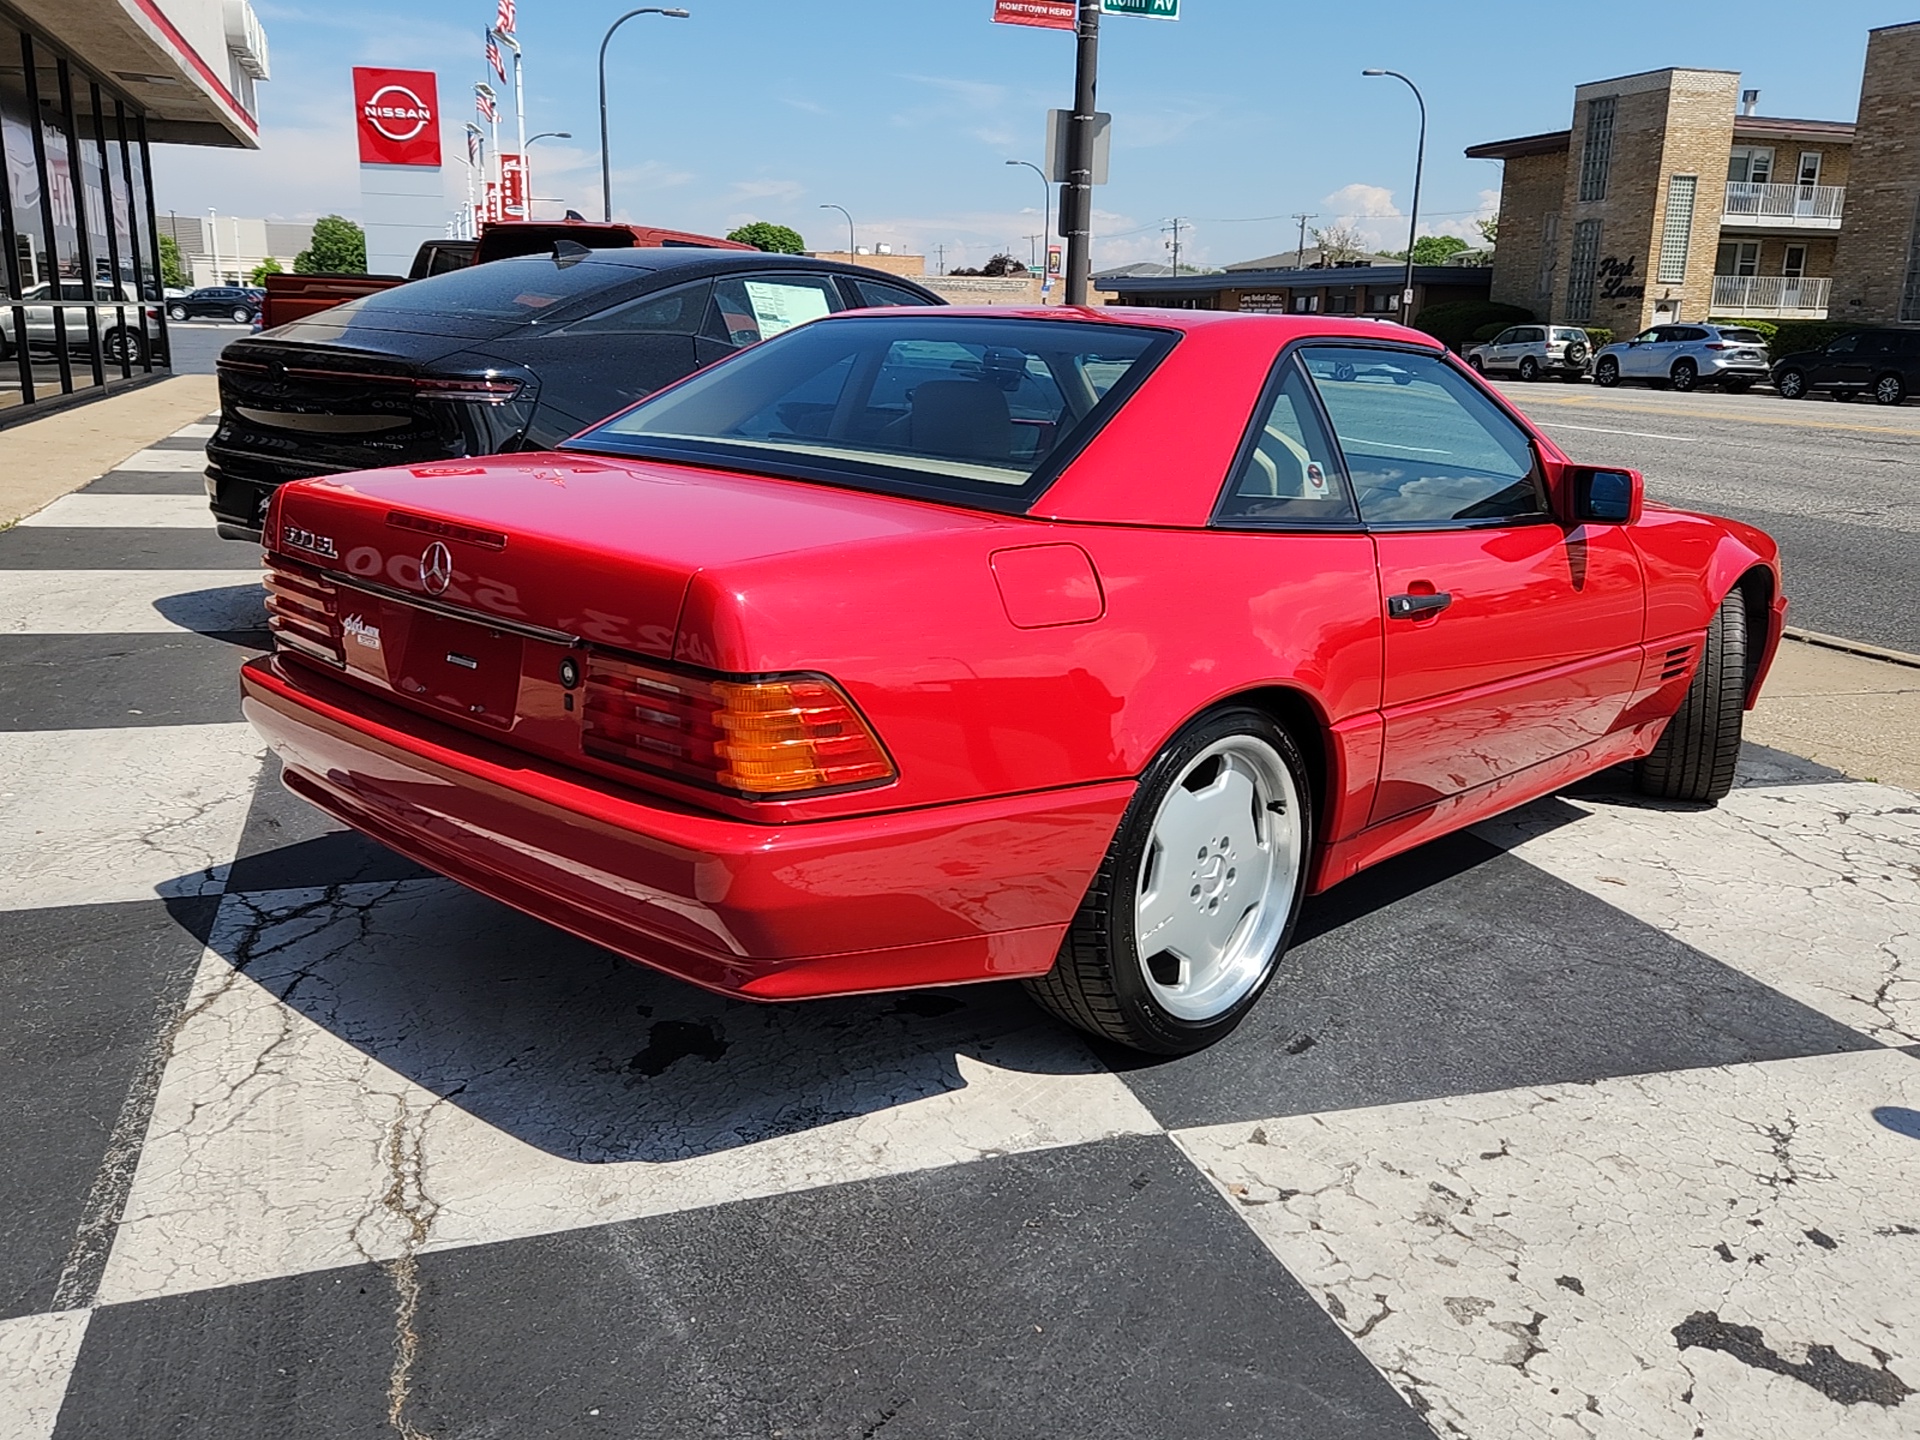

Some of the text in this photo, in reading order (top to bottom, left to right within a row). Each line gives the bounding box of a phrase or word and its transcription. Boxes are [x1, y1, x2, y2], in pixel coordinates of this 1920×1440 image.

[999, 2, 1073, 17] HOMETOWN HERO
[364, 106, 431, 120] NISSAN
[1597, 255, 1636, 278] Park
